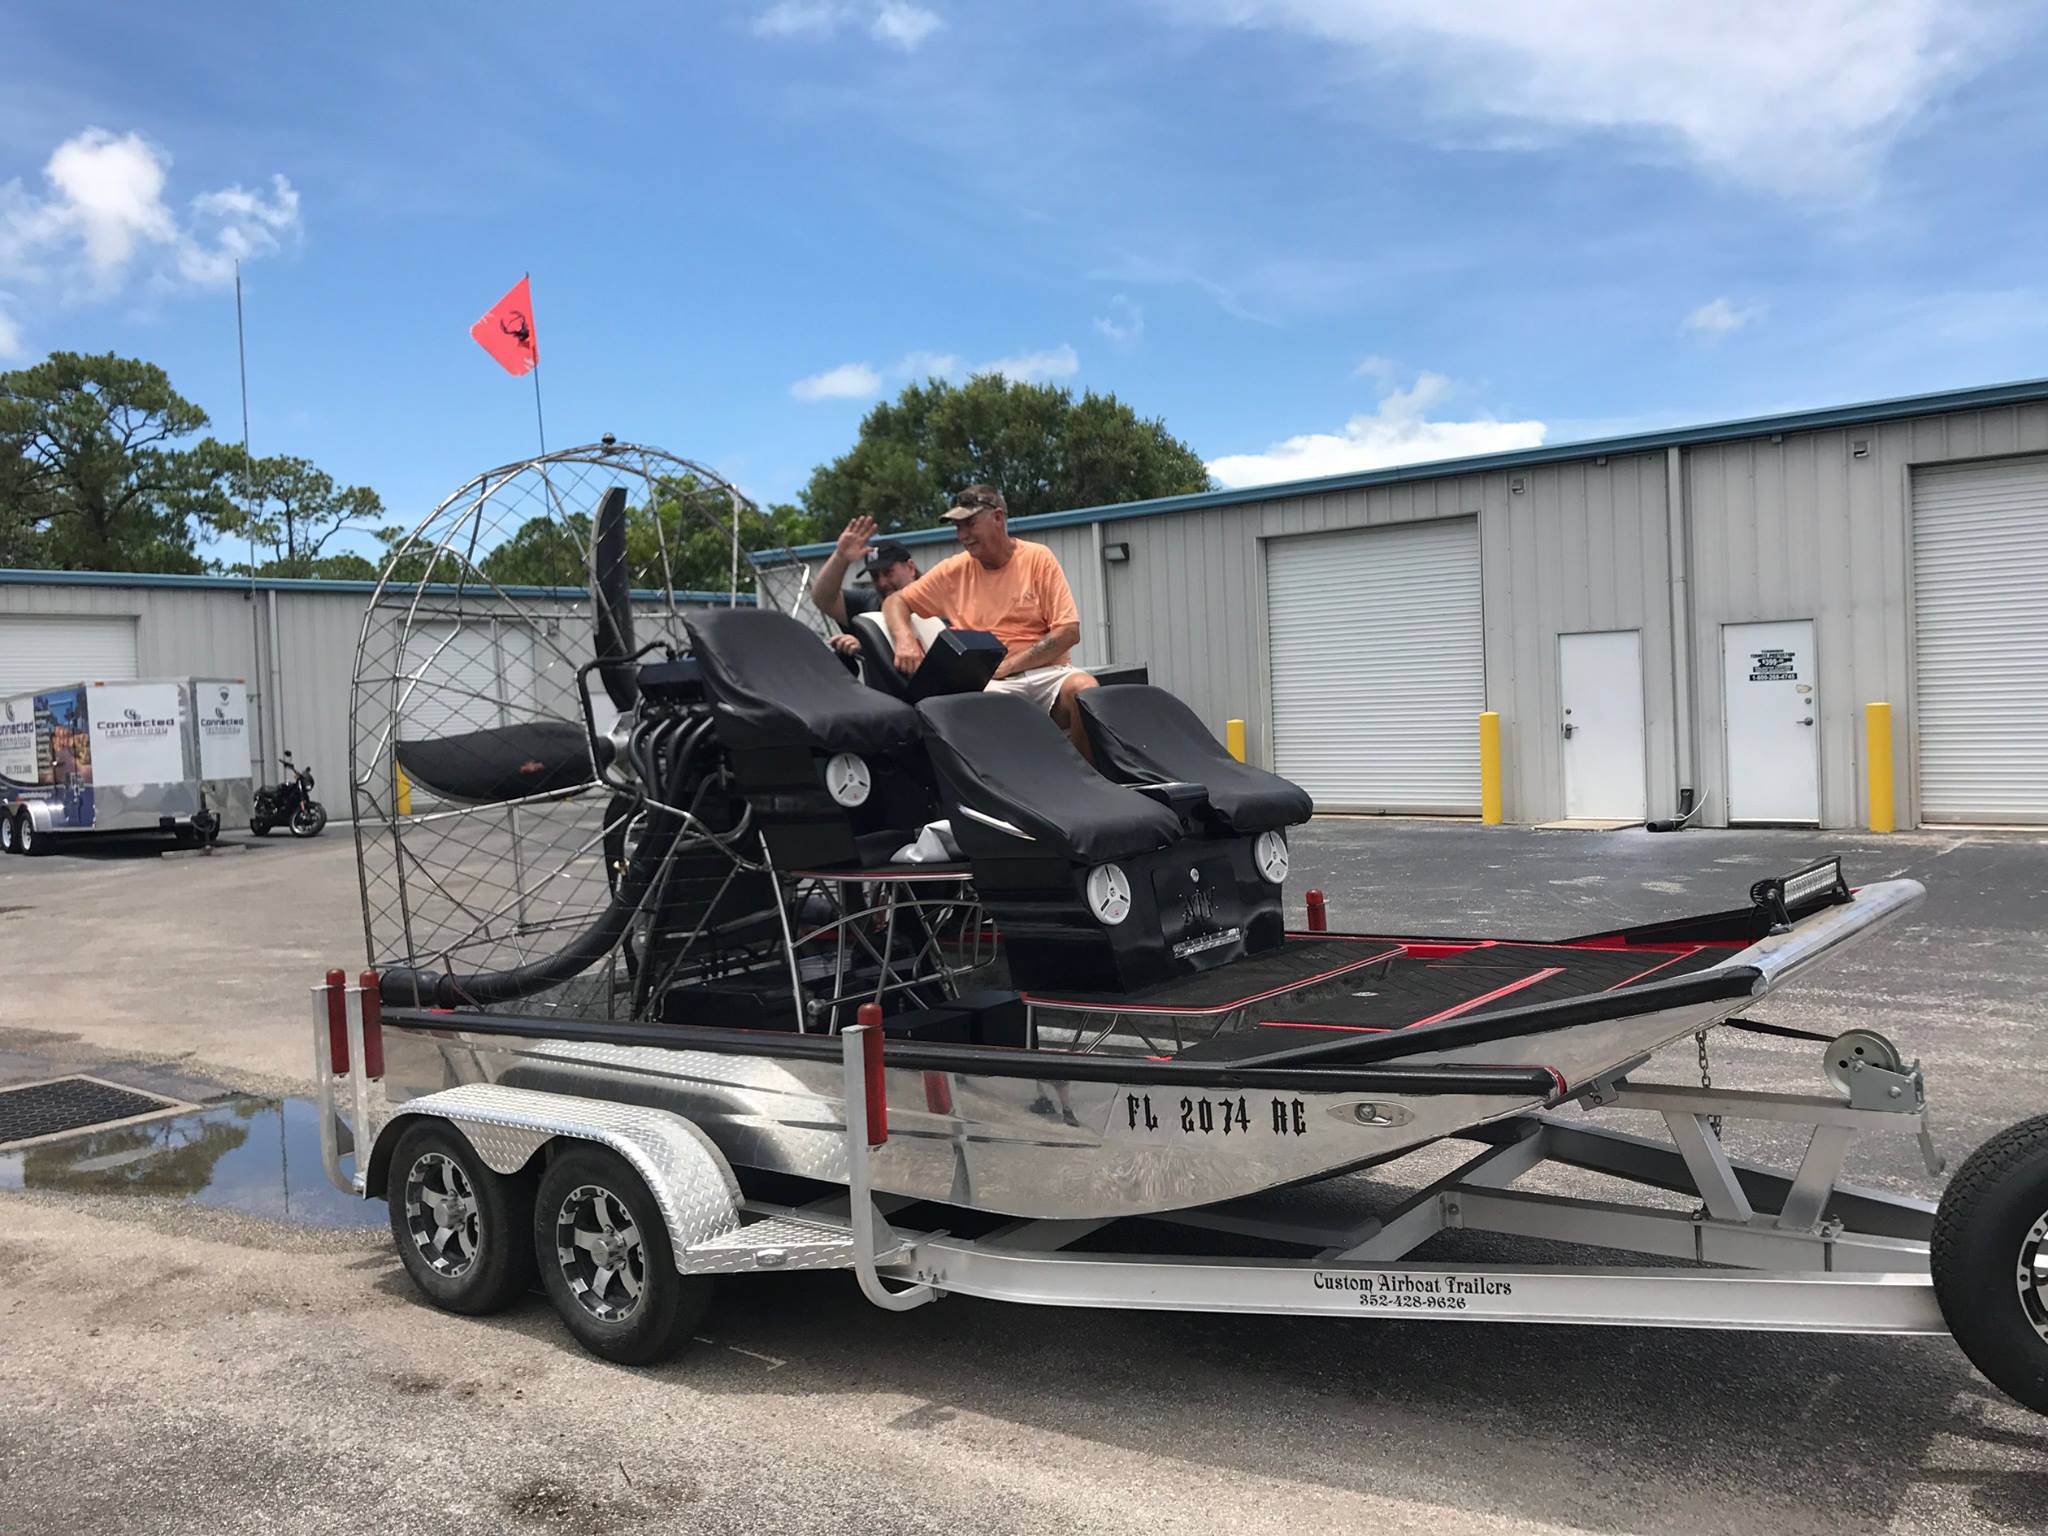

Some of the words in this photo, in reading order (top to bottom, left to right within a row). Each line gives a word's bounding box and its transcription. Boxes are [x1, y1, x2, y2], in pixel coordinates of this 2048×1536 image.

[97, 718, 175, 729] Connected
[1127, 1092, 1159, 1131] FL
[1180, 1095, 1251, 1136] 2074
[1313, 1271, 1373, 1293] Custom
[1377, 1273, 1442, 1294] Airboat
[1445, 1277, 1512, 1296] Trailers
[1360, 1294, 1467, 1310] 352-428-9626
